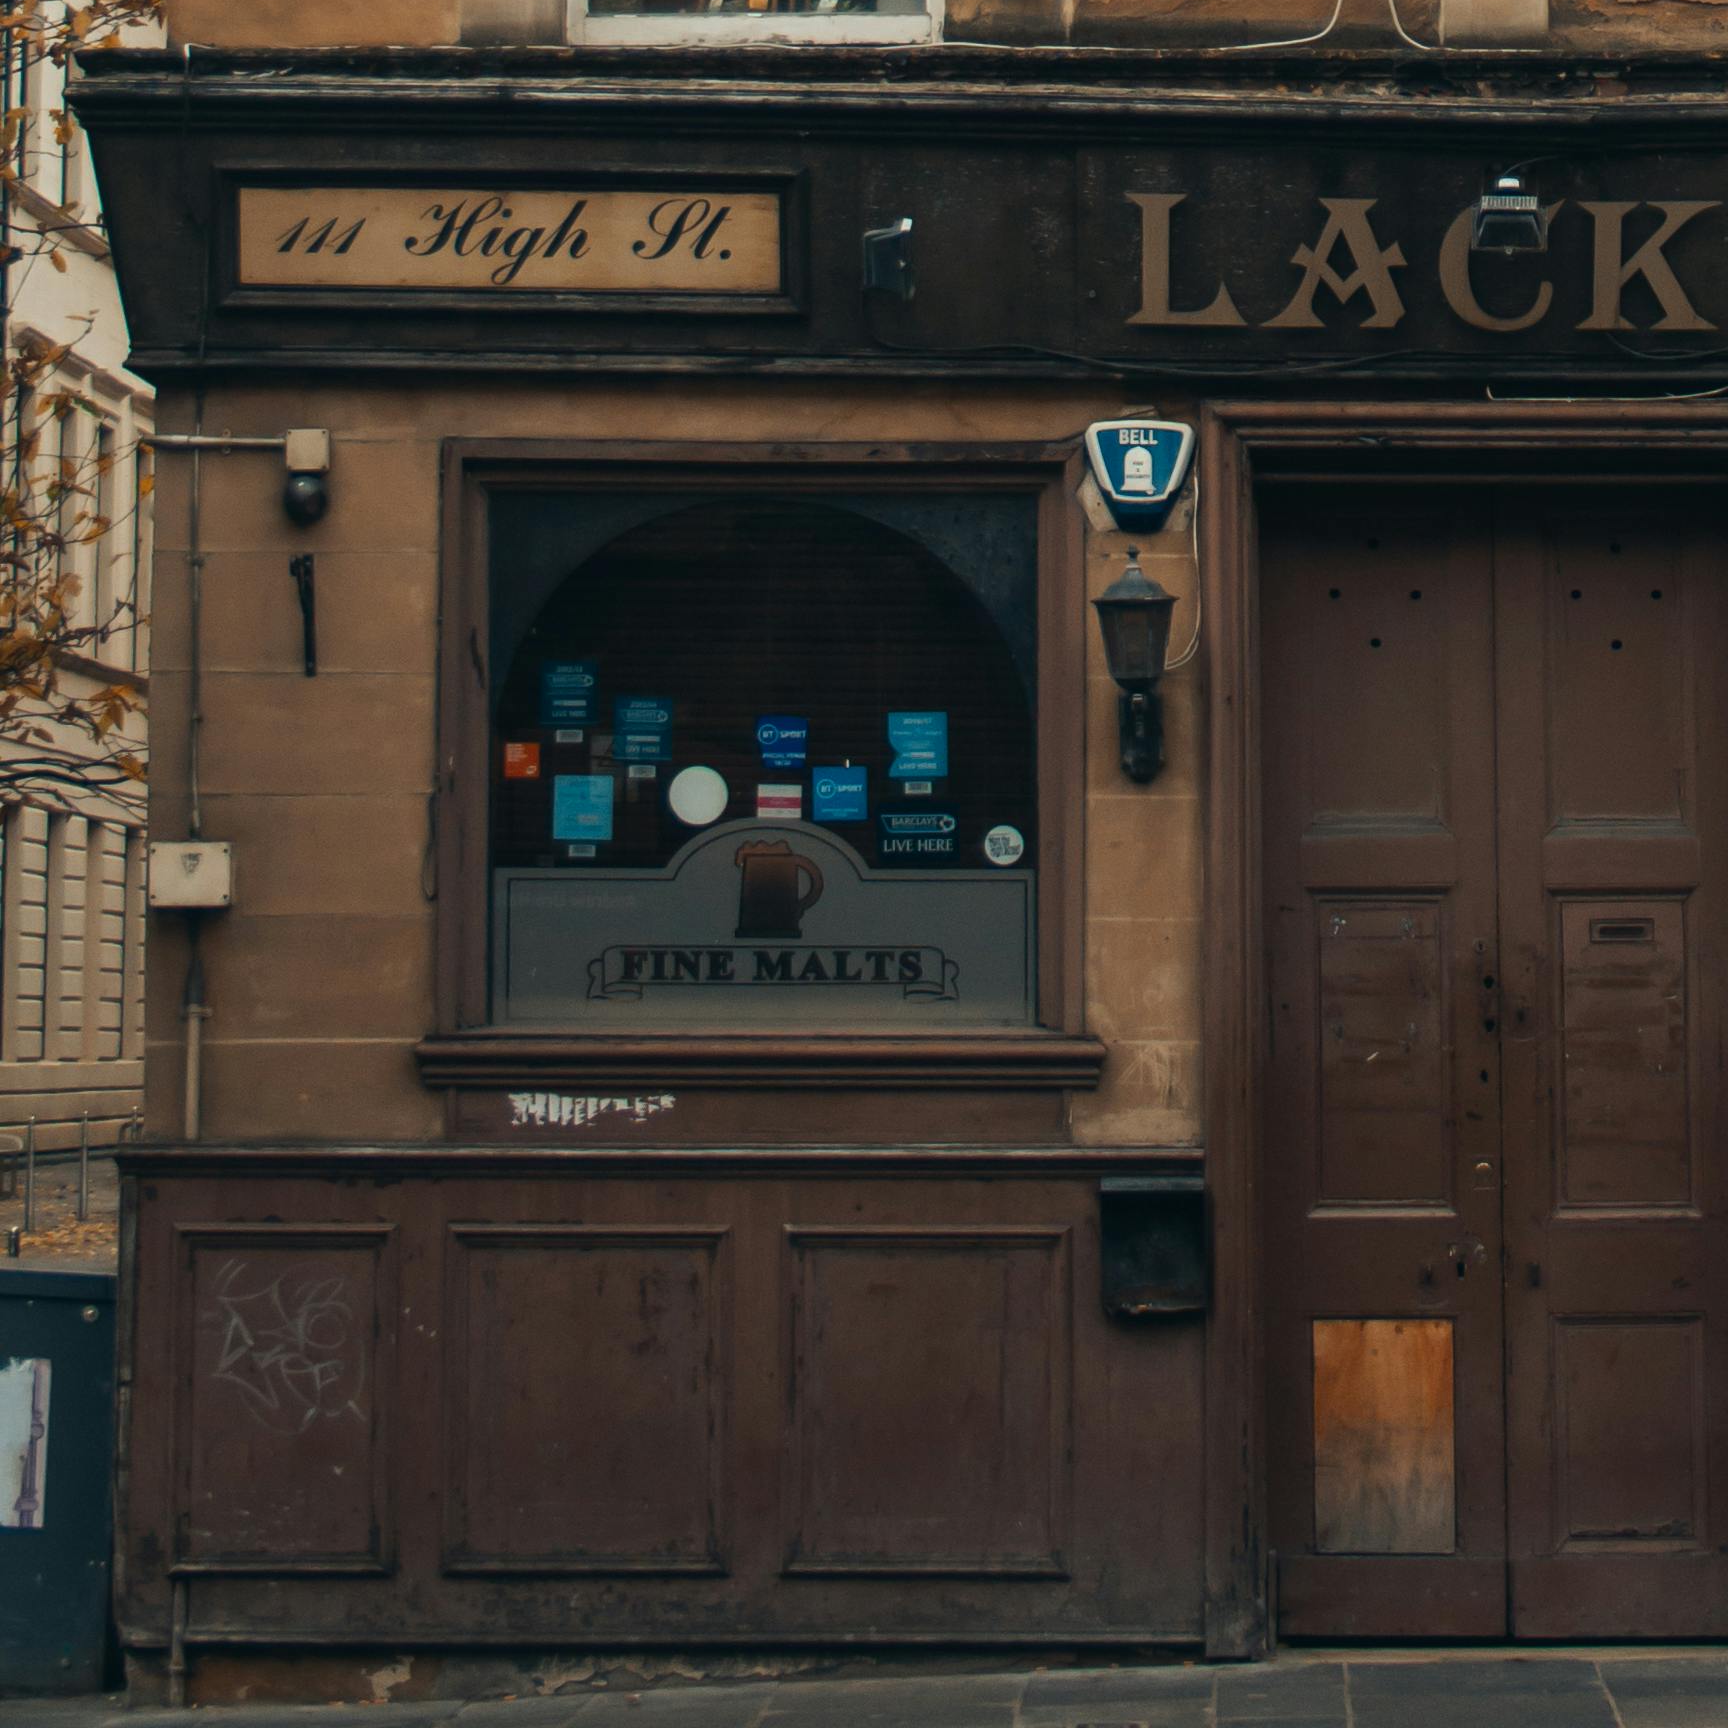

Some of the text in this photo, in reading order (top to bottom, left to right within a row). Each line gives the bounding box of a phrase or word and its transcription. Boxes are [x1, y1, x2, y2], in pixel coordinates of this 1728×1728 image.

[276, 197, 734, 285] 111 High St.
[1118, 429, 1158, 445] BELL
[891, 816, 938, 827] BARCLAYS
[883, 838, 954, 853] LIVE HERE
[619, 950, 924, 982] FINE MALTS
